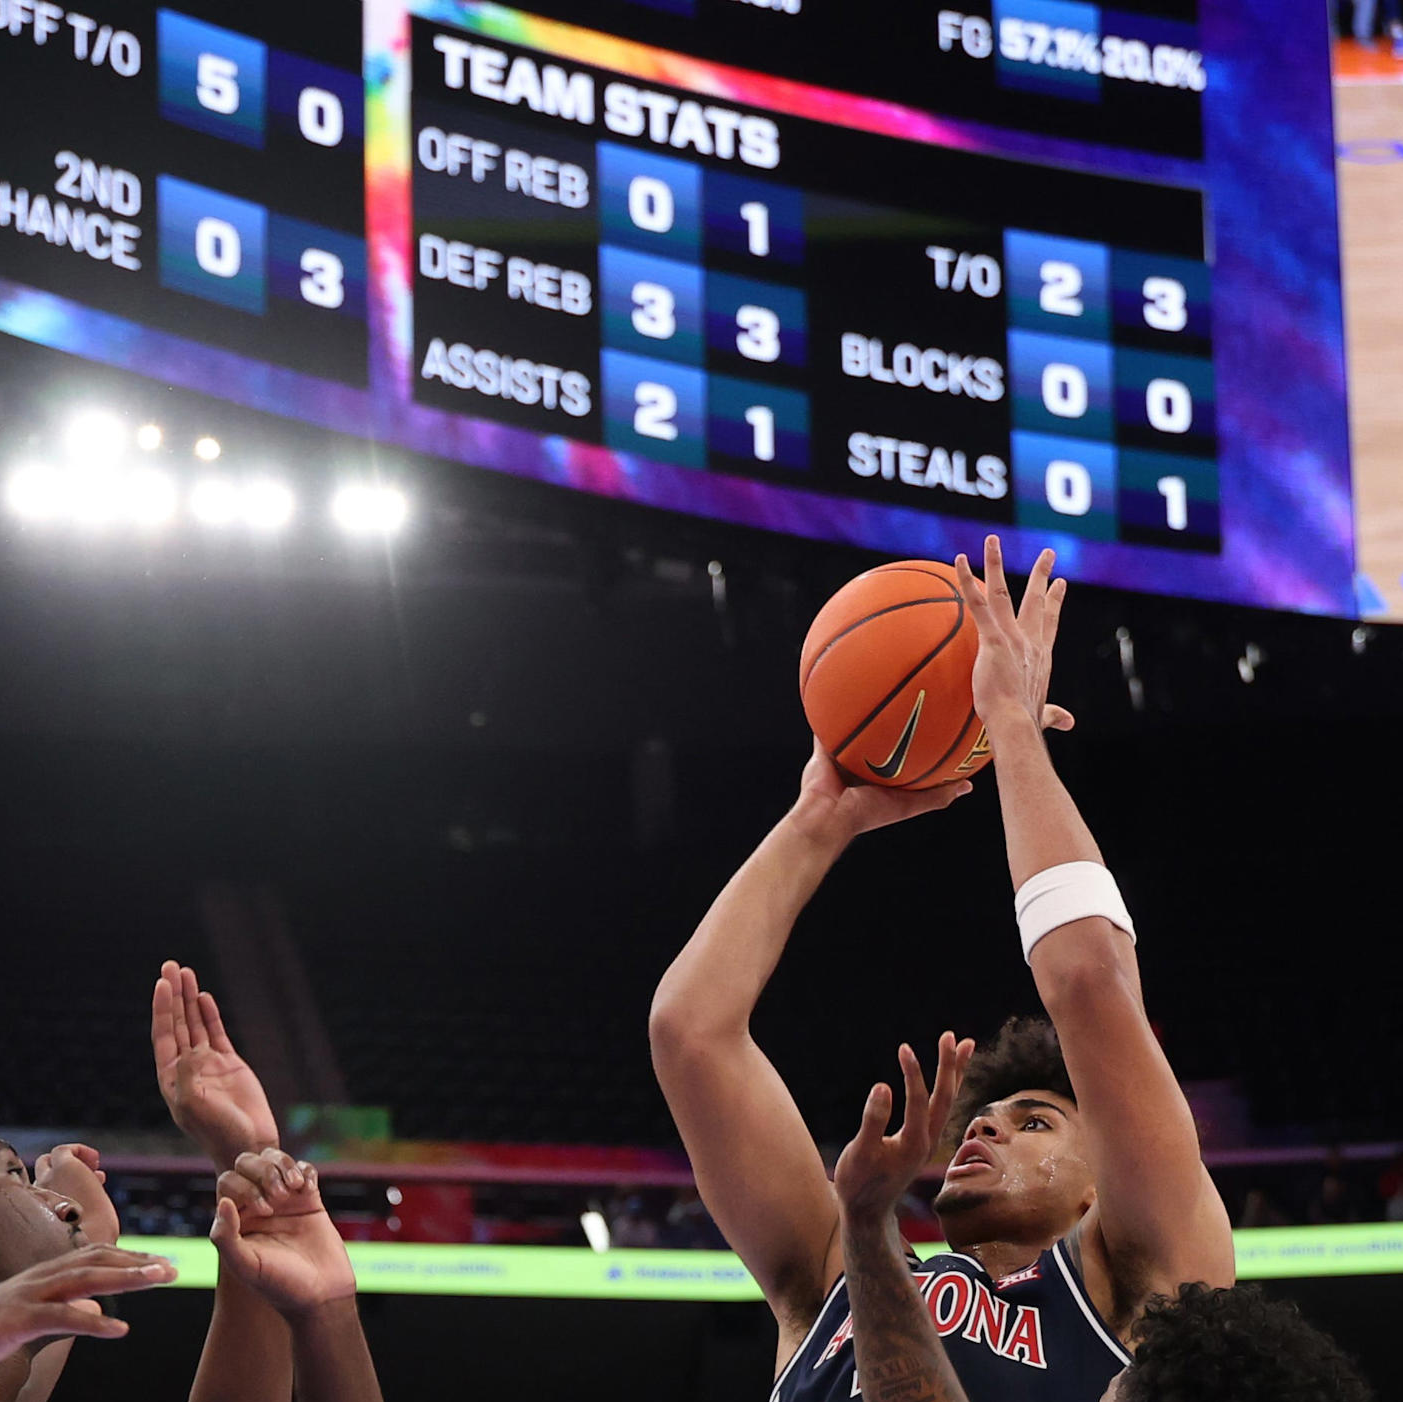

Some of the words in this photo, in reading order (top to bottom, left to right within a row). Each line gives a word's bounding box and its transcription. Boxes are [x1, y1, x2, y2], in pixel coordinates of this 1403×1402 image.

[67, 14, 141, 77] T/O
[938, 12, 991, 58] FG
[1101, 37, 1206, 91] 20.0%
[196, 53, 239, 114] 5
[433, 34, 595, 125] TEAM
[604, 82, 780, 169] STATS
[298, 88, 343, 146] 0
[54, 150, 142, 217] 2ND
[417, 126, 502, 183] OFF
[505, 150, 589, 208] REB
[628, 175, 674, 233] 0
[740, 202, 768, 256] 1
[195, 216, 241, 278] 0
[418, 233, 503, 291] DEF
[507, 258, 591, 315] REB
[925, 245, 1001, 298] T/O
[300, 248, 344, 309] 3
[1040, 260, 1083, 316] 2
[1143, 278, 1187, 331] 3
[631, 281, 676, 339] 3
[736, 306, 780, 362] 3
[421, 339, 590, 416] ASSISTS
[841, 334, 1003, 401] BLOCKS
[1041, 363, 1088, 418] 0
[634, 381, 677, 440] 2
[746, 406, 774, 461] 1
[1146, 379, 1192, 433] 0
[848, 432, 1006, 498] STEALS
[1045, 460, 1092, 516] 0
[1158, 477, 1187, 530] 1
